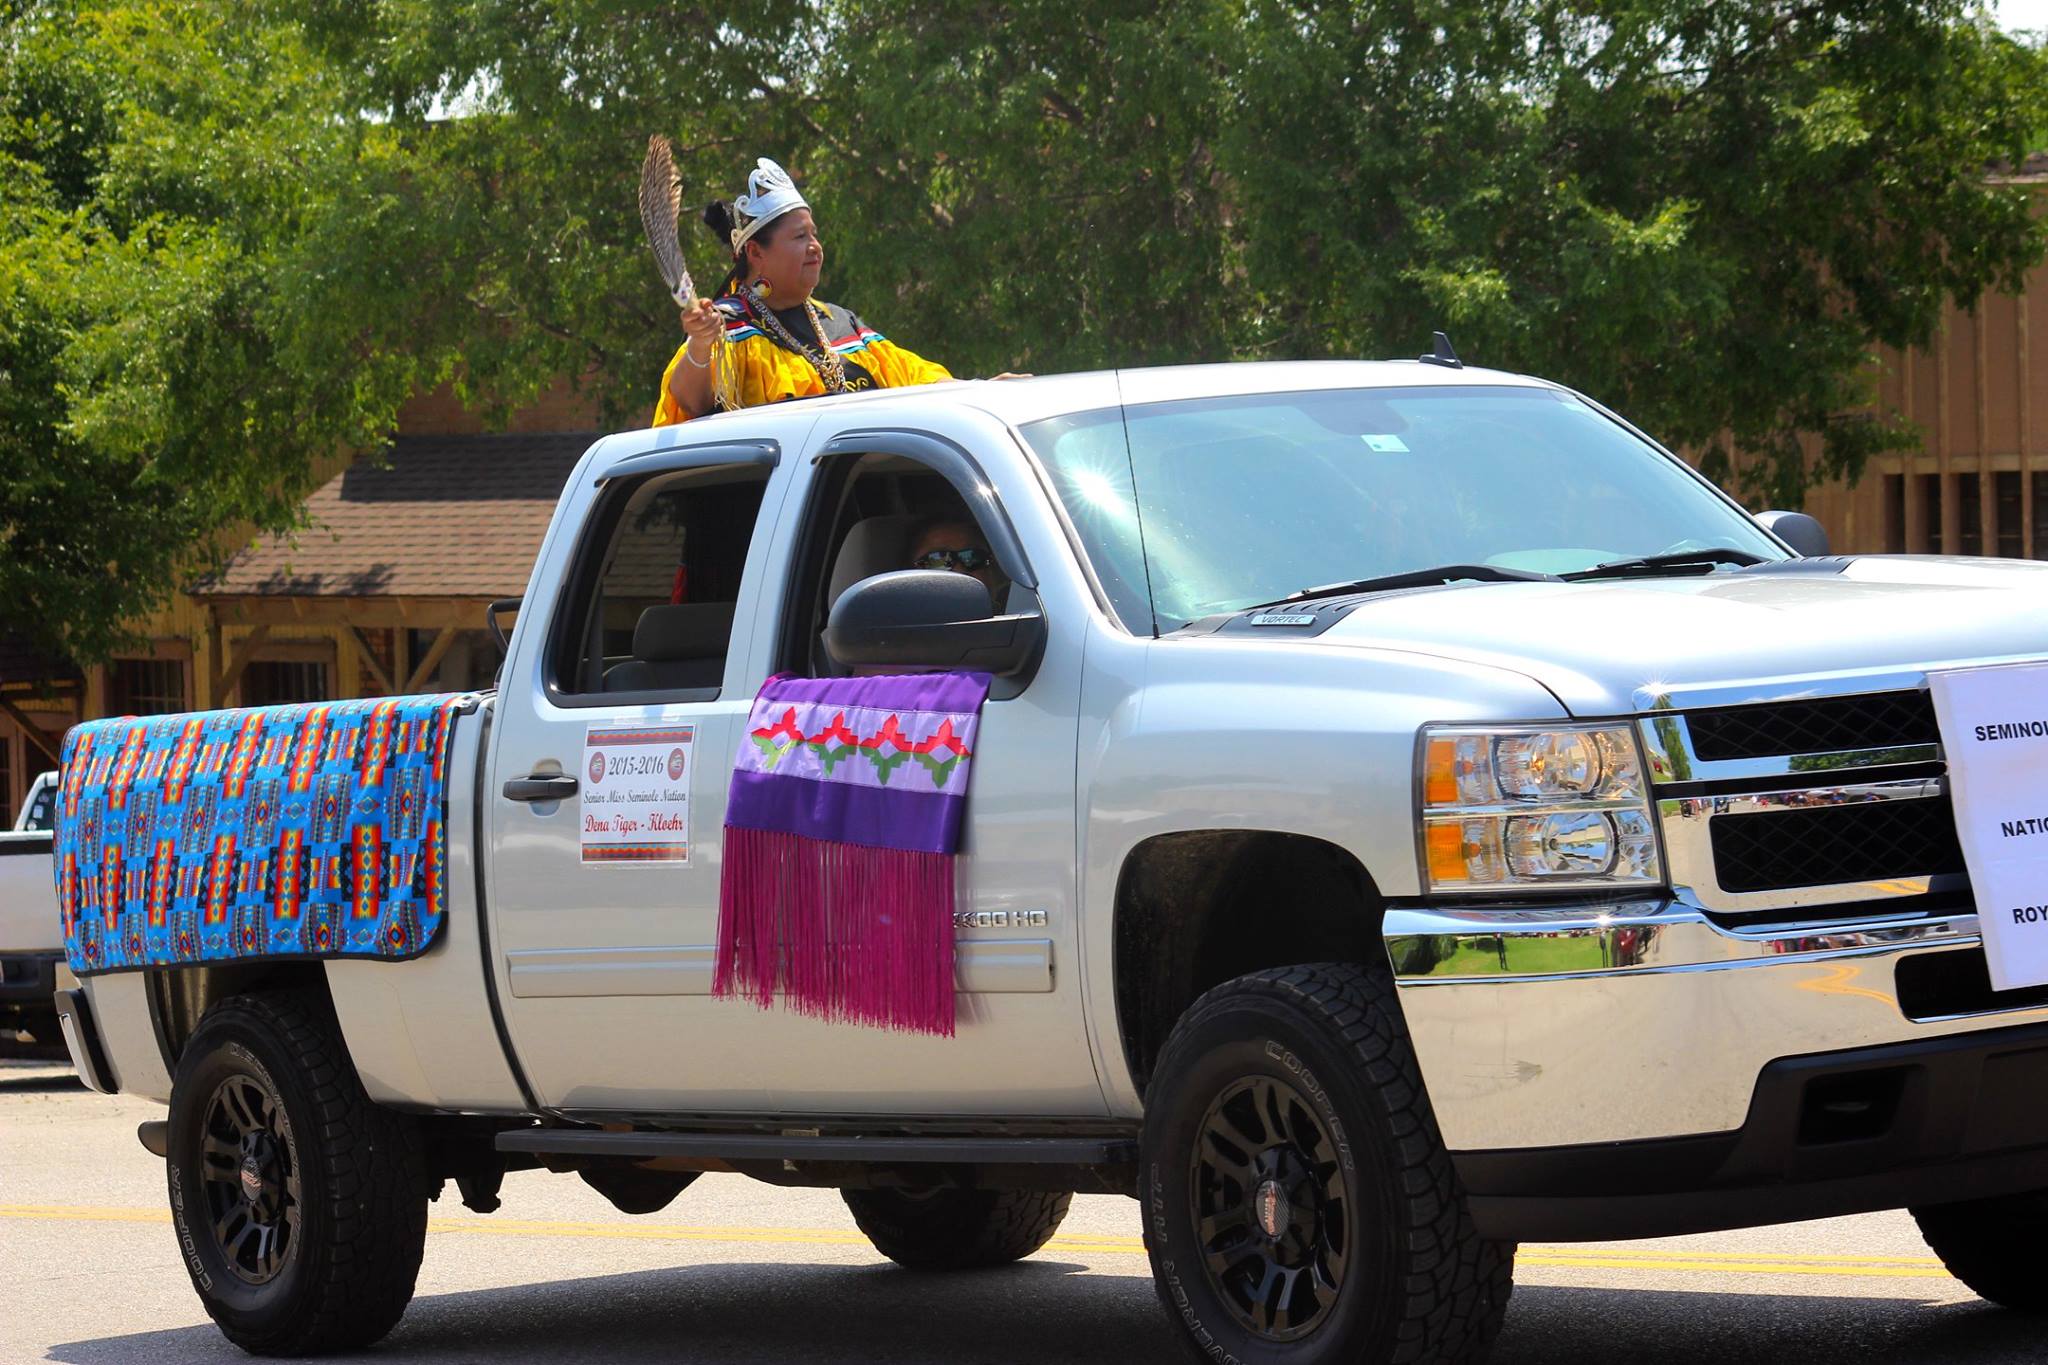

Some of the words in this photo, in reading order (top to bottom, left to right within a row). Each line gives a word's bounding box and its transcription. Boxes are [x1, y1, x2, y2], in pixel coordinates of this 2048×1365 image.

[1261, 615, 1306, 624] VORTEC
[608, 755, 664, 776] 2015-2016
[583, 790, 605, 804] Senior
[606, 789, 625, 803] Miss
[626, 788, 659, 803] Seminole
[660, 788, 686, 803] Nation
[584, 814, 609, 833] Dena
[611, 813, 638, 837] Tiger
[1012, 910, 1048, 928] HD
[2012, 905, 2048, 924] ROY
[1265, 1040, 1354, 1170] COOPER
[171, 1165, 213, 1291] COOPER
